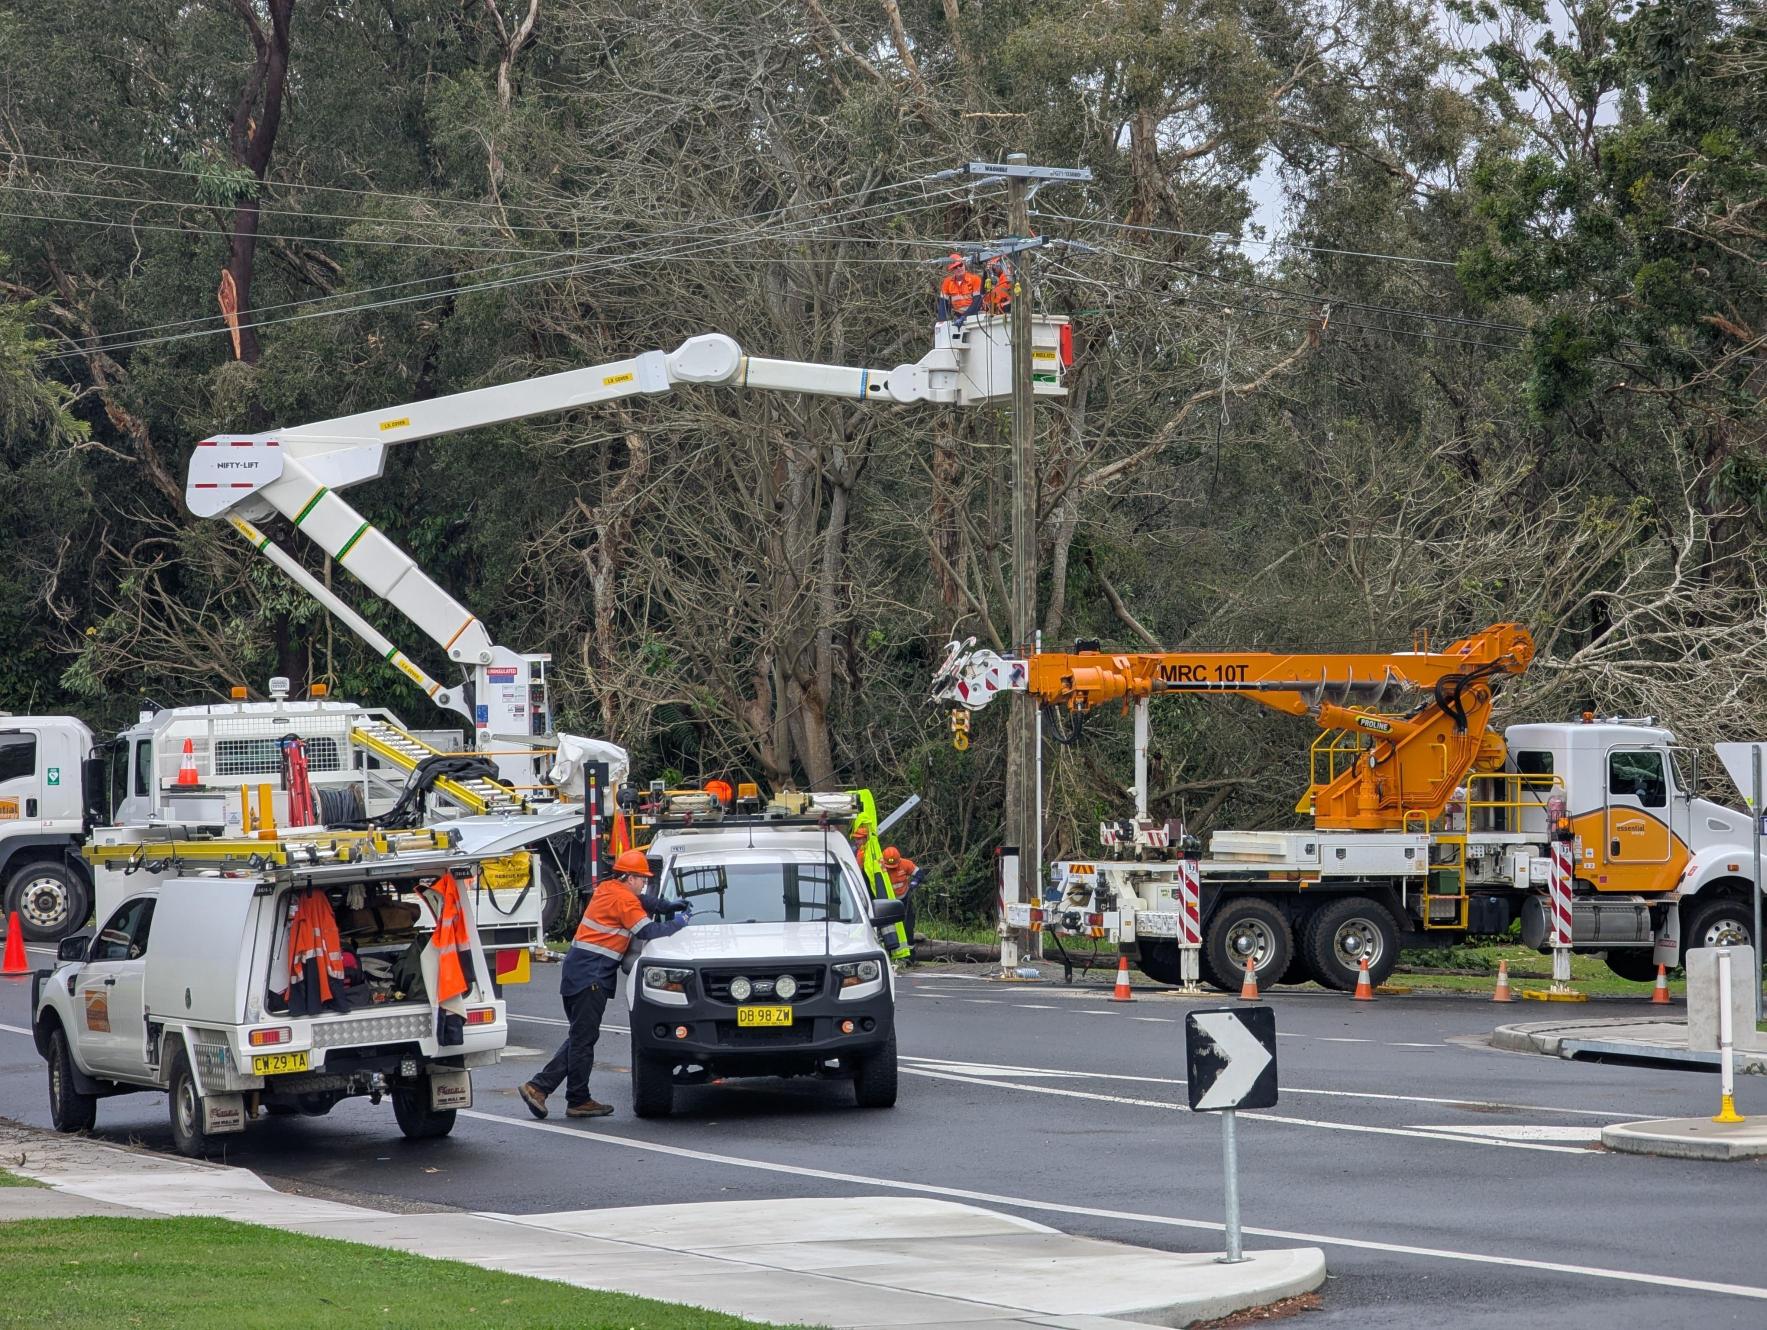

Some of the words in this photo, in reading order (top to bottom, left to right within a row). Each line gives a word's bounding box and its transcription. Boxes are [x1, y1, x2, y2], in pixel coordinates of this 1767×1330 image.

[1160, 664, 1207, 682] MRC
[1214, 664, 1249, 682] 10T
[1360, 718, 1389, 731] PROLINE
